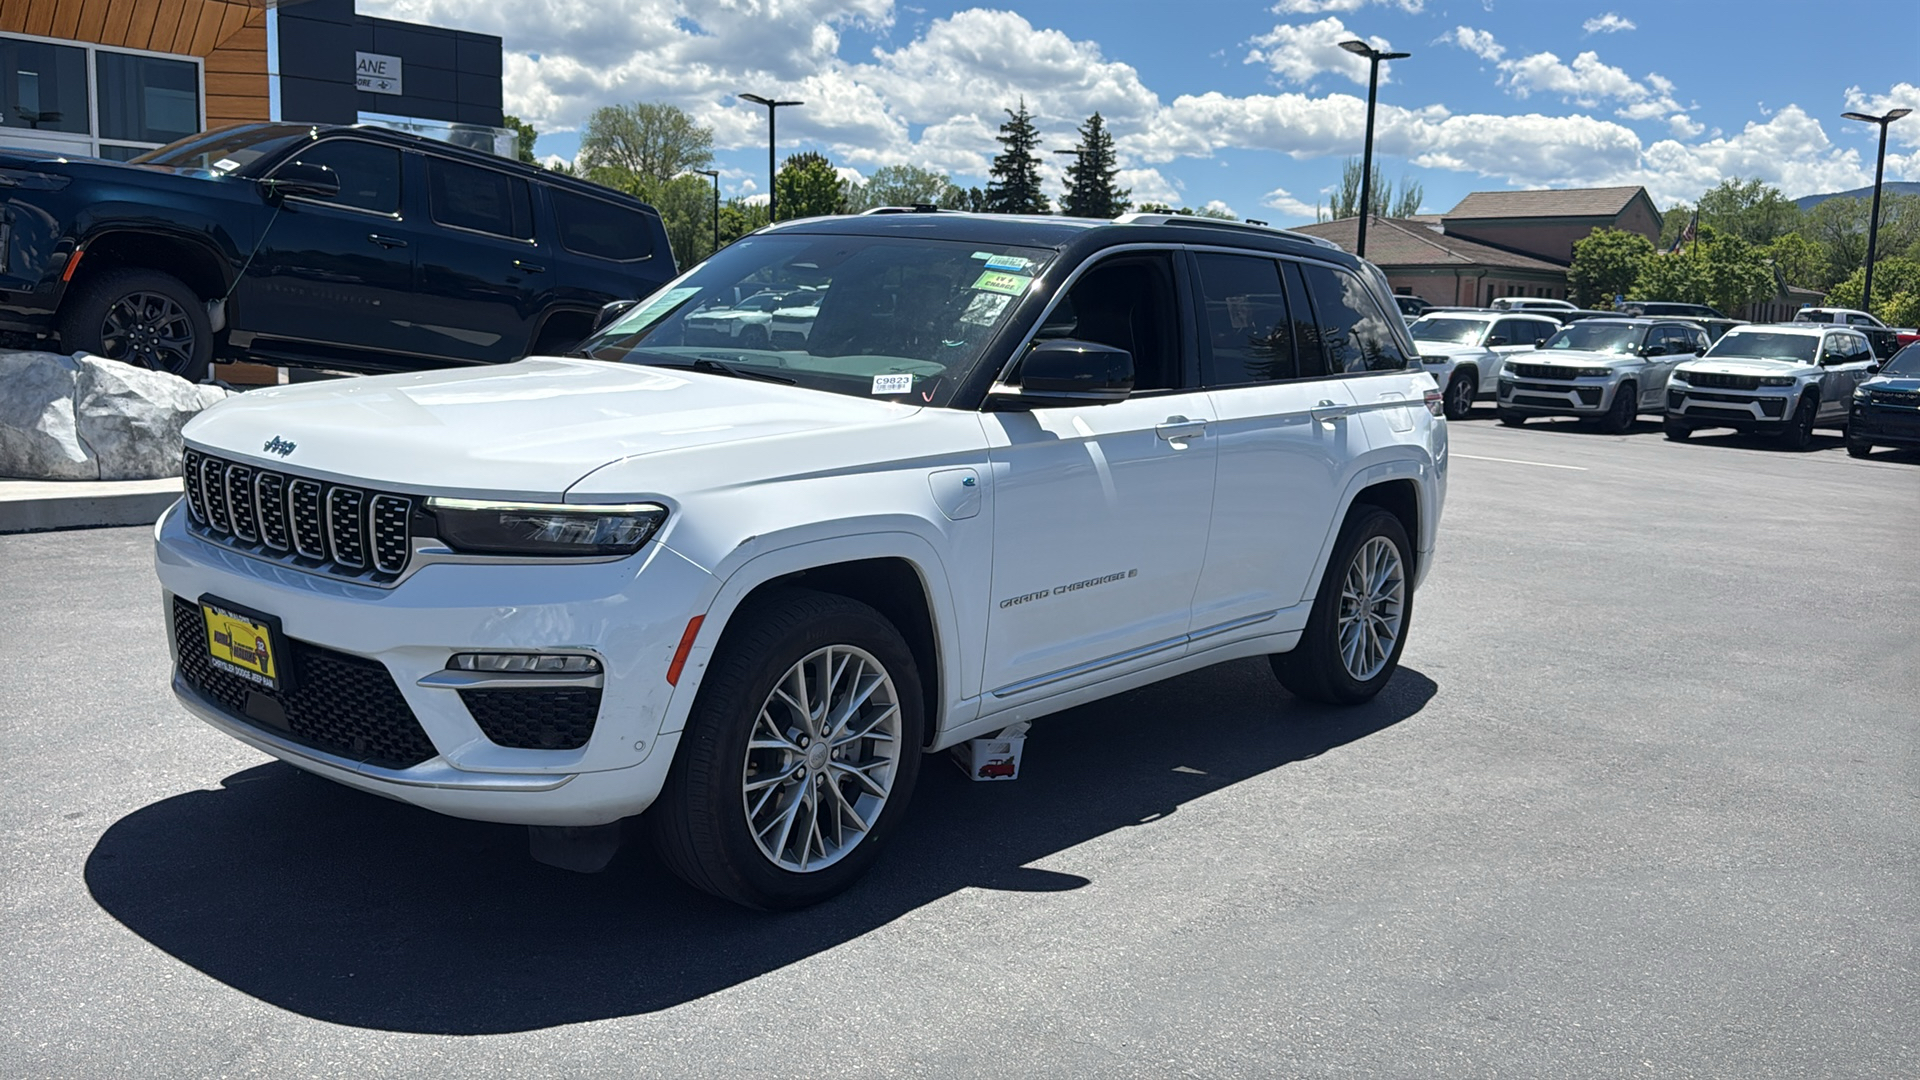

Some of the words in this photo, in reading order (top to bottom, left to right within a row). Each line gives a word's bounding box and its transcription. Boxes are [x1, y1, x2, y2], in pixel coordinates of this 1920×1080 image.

[876, 376, 910, 385] C9823
[1000, 589, 1050, 609] GRAND
[1053, 571, 1126, 596] CHEROKEE
